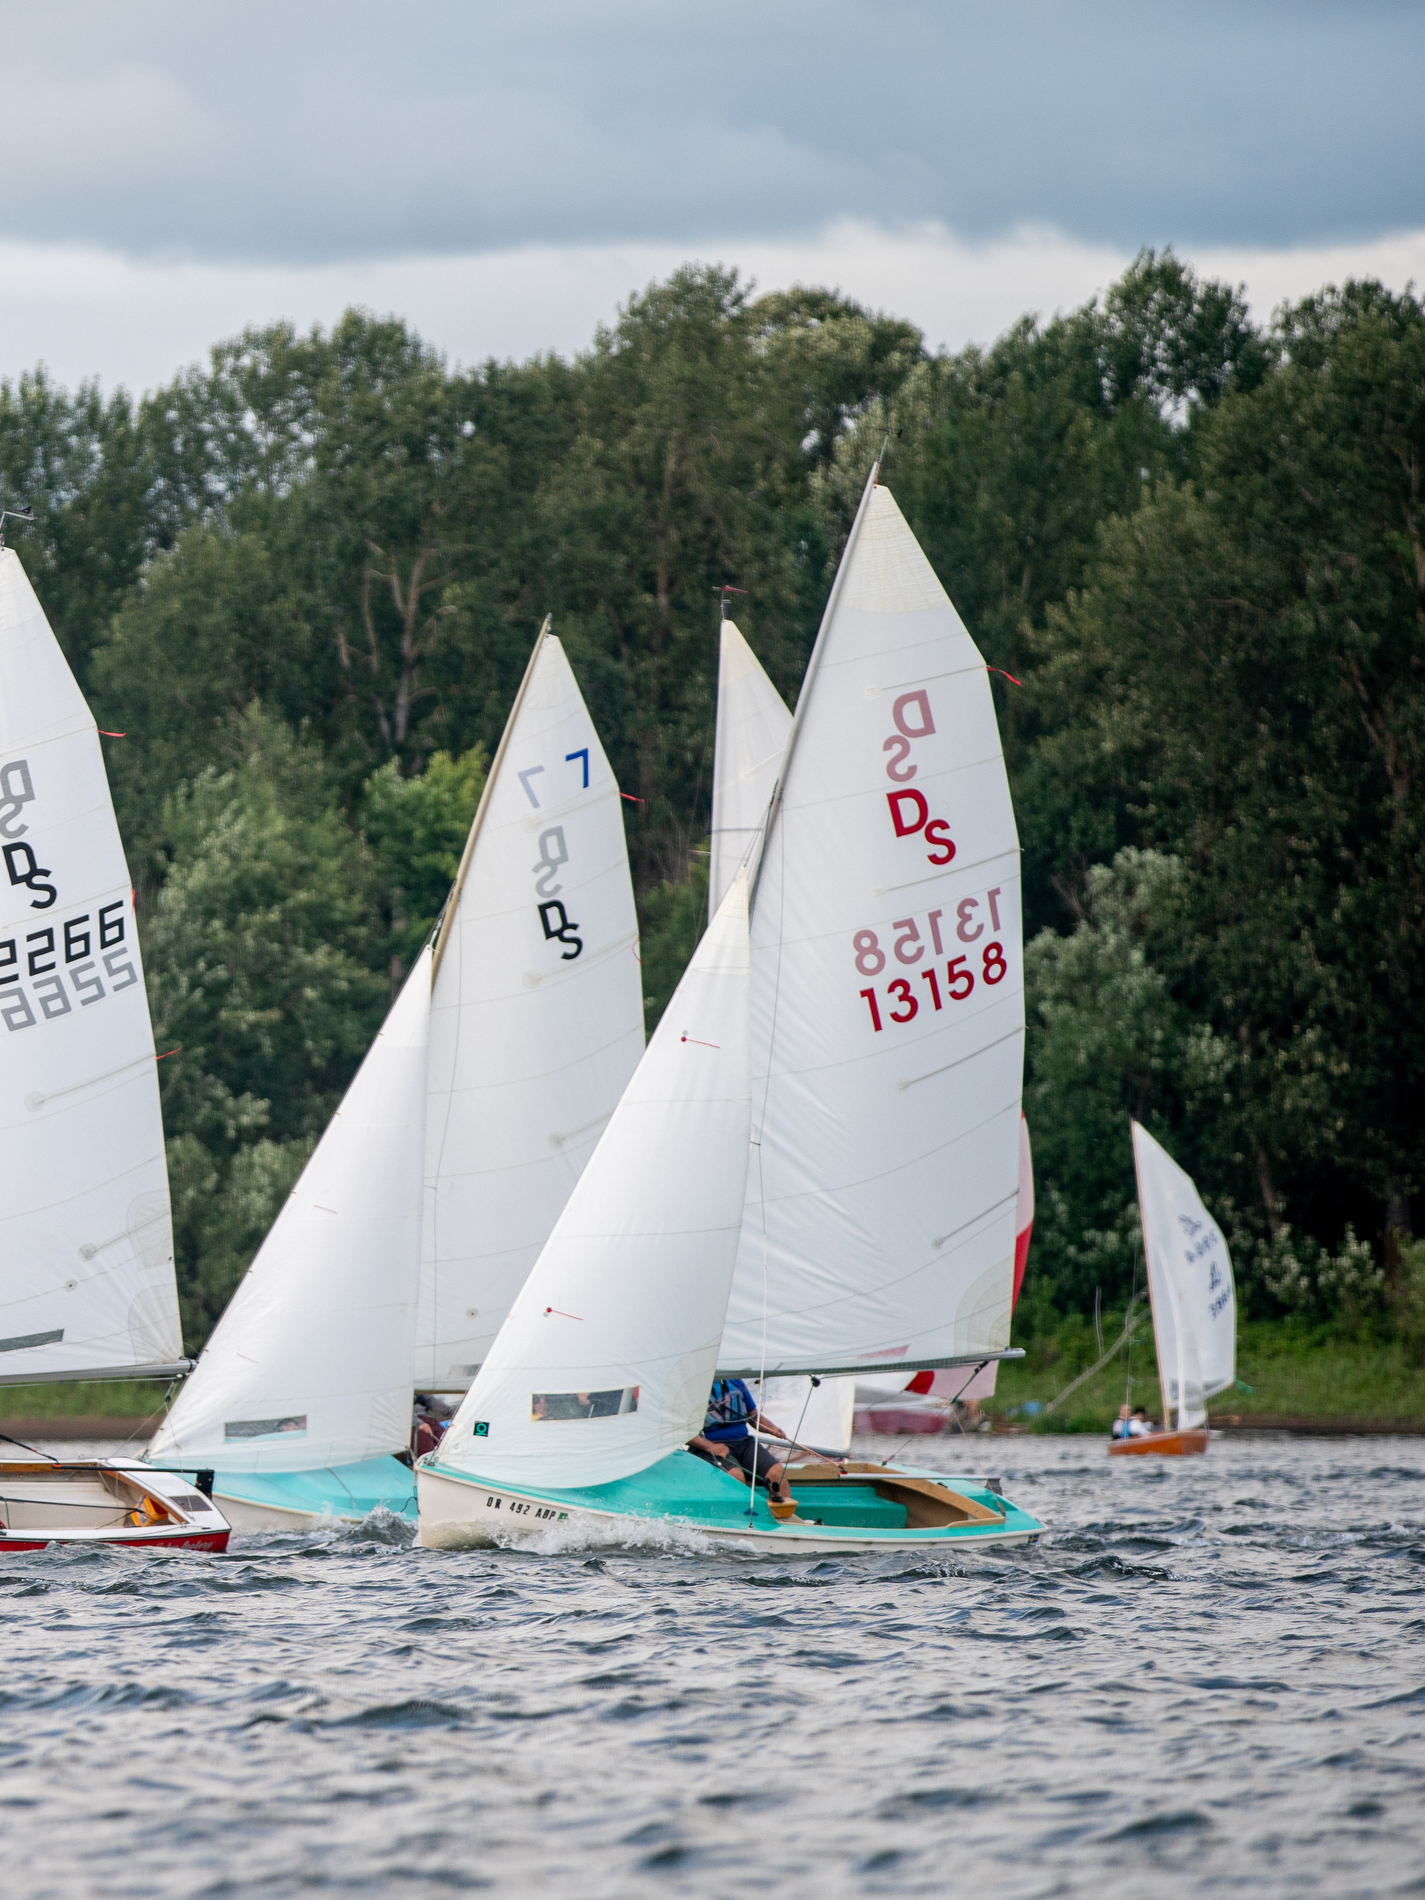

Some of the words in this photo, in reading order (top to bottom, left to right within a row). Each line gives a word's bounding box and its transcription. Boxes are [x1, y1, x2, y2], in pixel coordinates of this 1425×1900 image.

[565, 747, 589, 789] 7
[886, 788, 956, 865] DS
[2, 841, 58, 909] DS
[537, 899, 583, 960] DS
[860, 941, 1007, 1032] 13158
[486, 1496, 501, 1509] OR
[509, 1501, 531, 1515] 492
